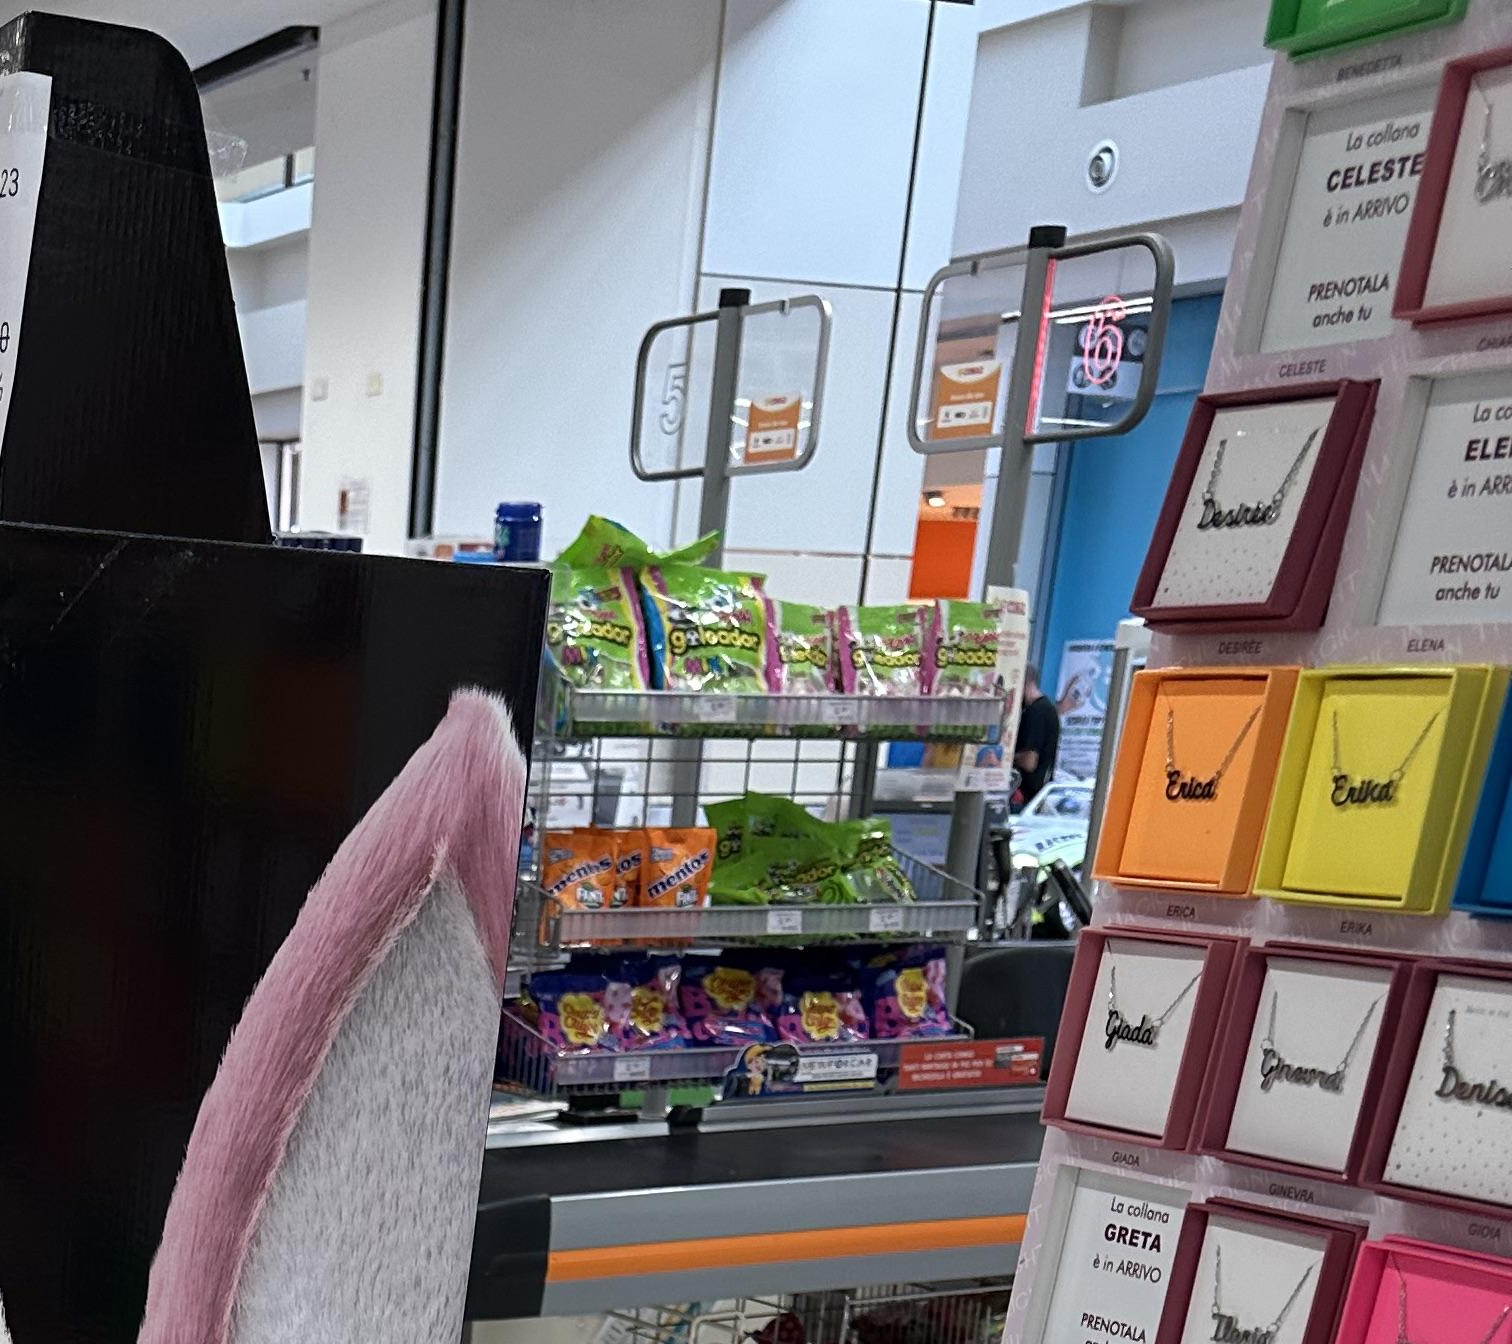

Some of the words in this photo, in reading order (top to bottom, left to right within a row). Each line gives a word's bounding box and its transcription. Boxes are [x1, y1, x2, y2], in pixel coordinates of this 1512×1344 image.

[1345, 133, 1363, 151] La
[1367, 123, 1420, 147] collana
[1327, 153, 1426, 192] CELESTE
[1335, 205, 1349, 223] in
[1351, 193, 1410, 222] ARRIVO
[1308, 274, 1389, 302] PRENOTALA
[1313, 310, 1354, 328] anche
[1358, 306, 1372, 322] tu
[1279, 360, 1327, 378] CELESTE
[1473, 404, 1489, 423] La
[1461, 477, 1476, 496] in
[1436, 581, 1481, 601] anche
[1485, 583, 1500, 599] tu
[1407, 639, 1445, 654] ELENA
[1166, 768, 1218, 801] Erica
[647, 851, 711, 899] mentos
[1166, 905, 1198, 919] ERICA
[1104, 1007, 1157, 1050] Giada
[1112, 1151, 1140, 1166] GIADA
[1268, 1181, 1315, 1203] GINEVRA
[1111, 1196, 1124, 1213] La
[1127, 1201, 1170, 1224] collana
[1104, 1223, 1162, 1253] GRETA
[1093, 1254, 1100, 1269] è
[1103, 1254, 1114, 1272] in
[1116, 1259, 1162, 1284] ARRIVO
[1080, 1312, 1146, 1343] PRENOTALA
